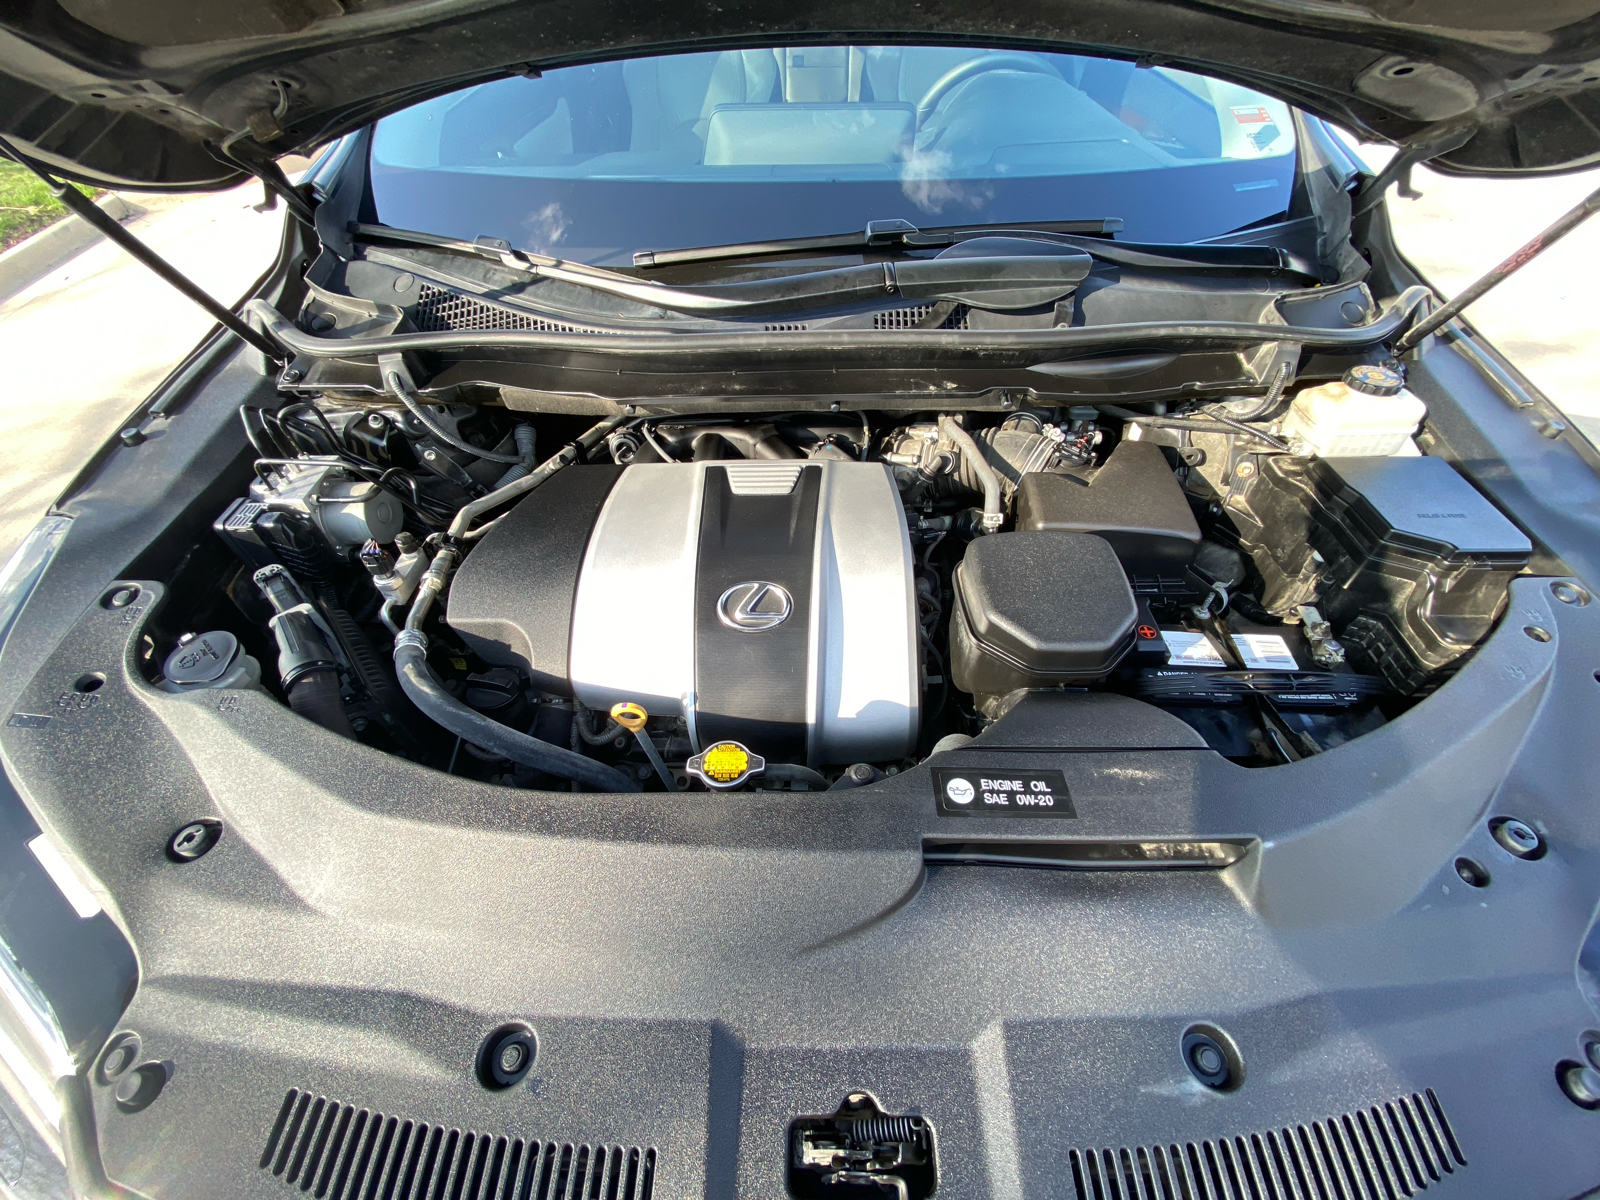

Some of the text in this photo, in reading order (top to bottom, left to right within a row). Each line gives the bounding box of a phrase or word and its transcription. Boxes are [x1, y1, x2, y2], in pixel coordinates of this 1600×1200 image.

[980, 778, 1052, 792] ENGINE OIL
[983, 793, 1054, 806] SAE 0W-20
